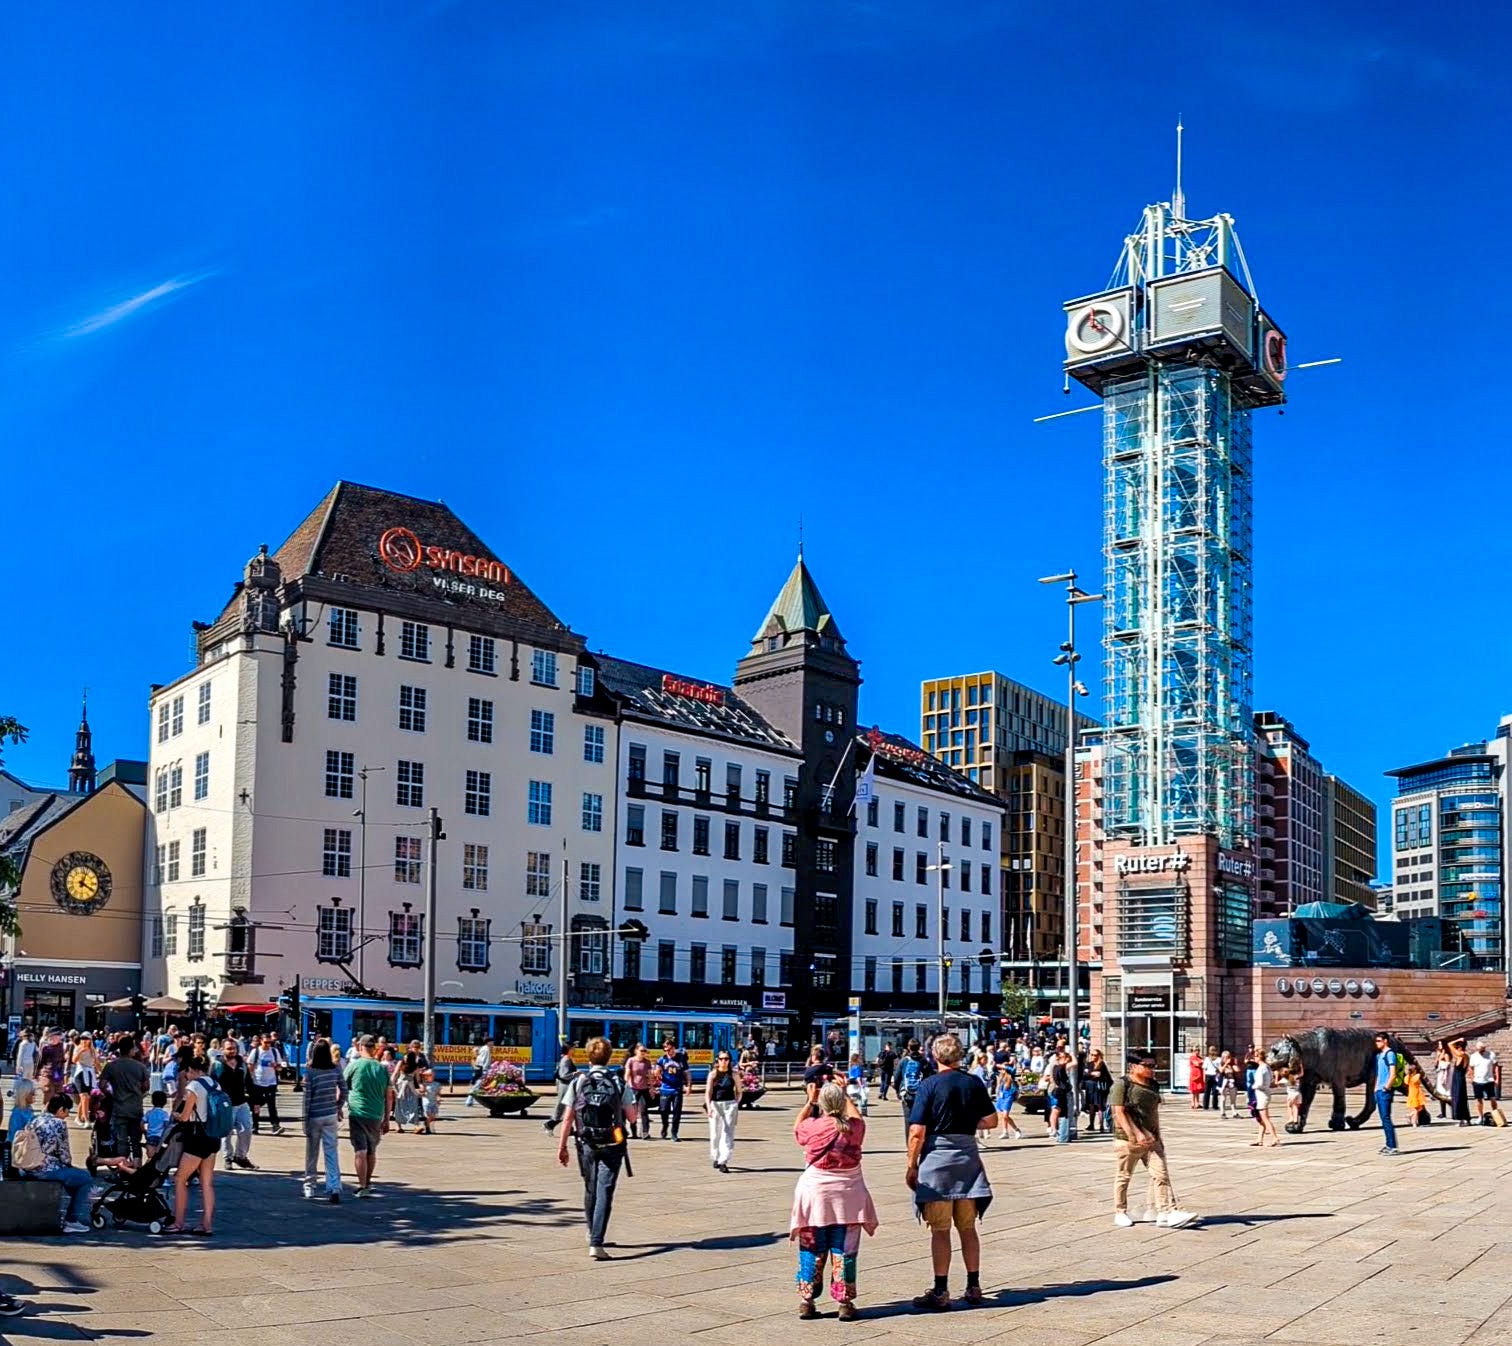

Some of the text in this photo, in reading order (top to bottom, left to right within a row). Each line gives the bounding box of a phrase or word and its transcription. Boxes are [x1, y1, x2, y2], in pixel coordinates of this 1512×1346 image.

[426, 546, 510, 583] SYNSAM
[479, 588, 505, 601] DEG
[1113, 850, 1187, 873] Ruter#
[1218, 852, 1252, 876] Ruter#
[17, 973, 86, 984] HELLY HANSEN
[303, 978, 340, 990] PEPPES
